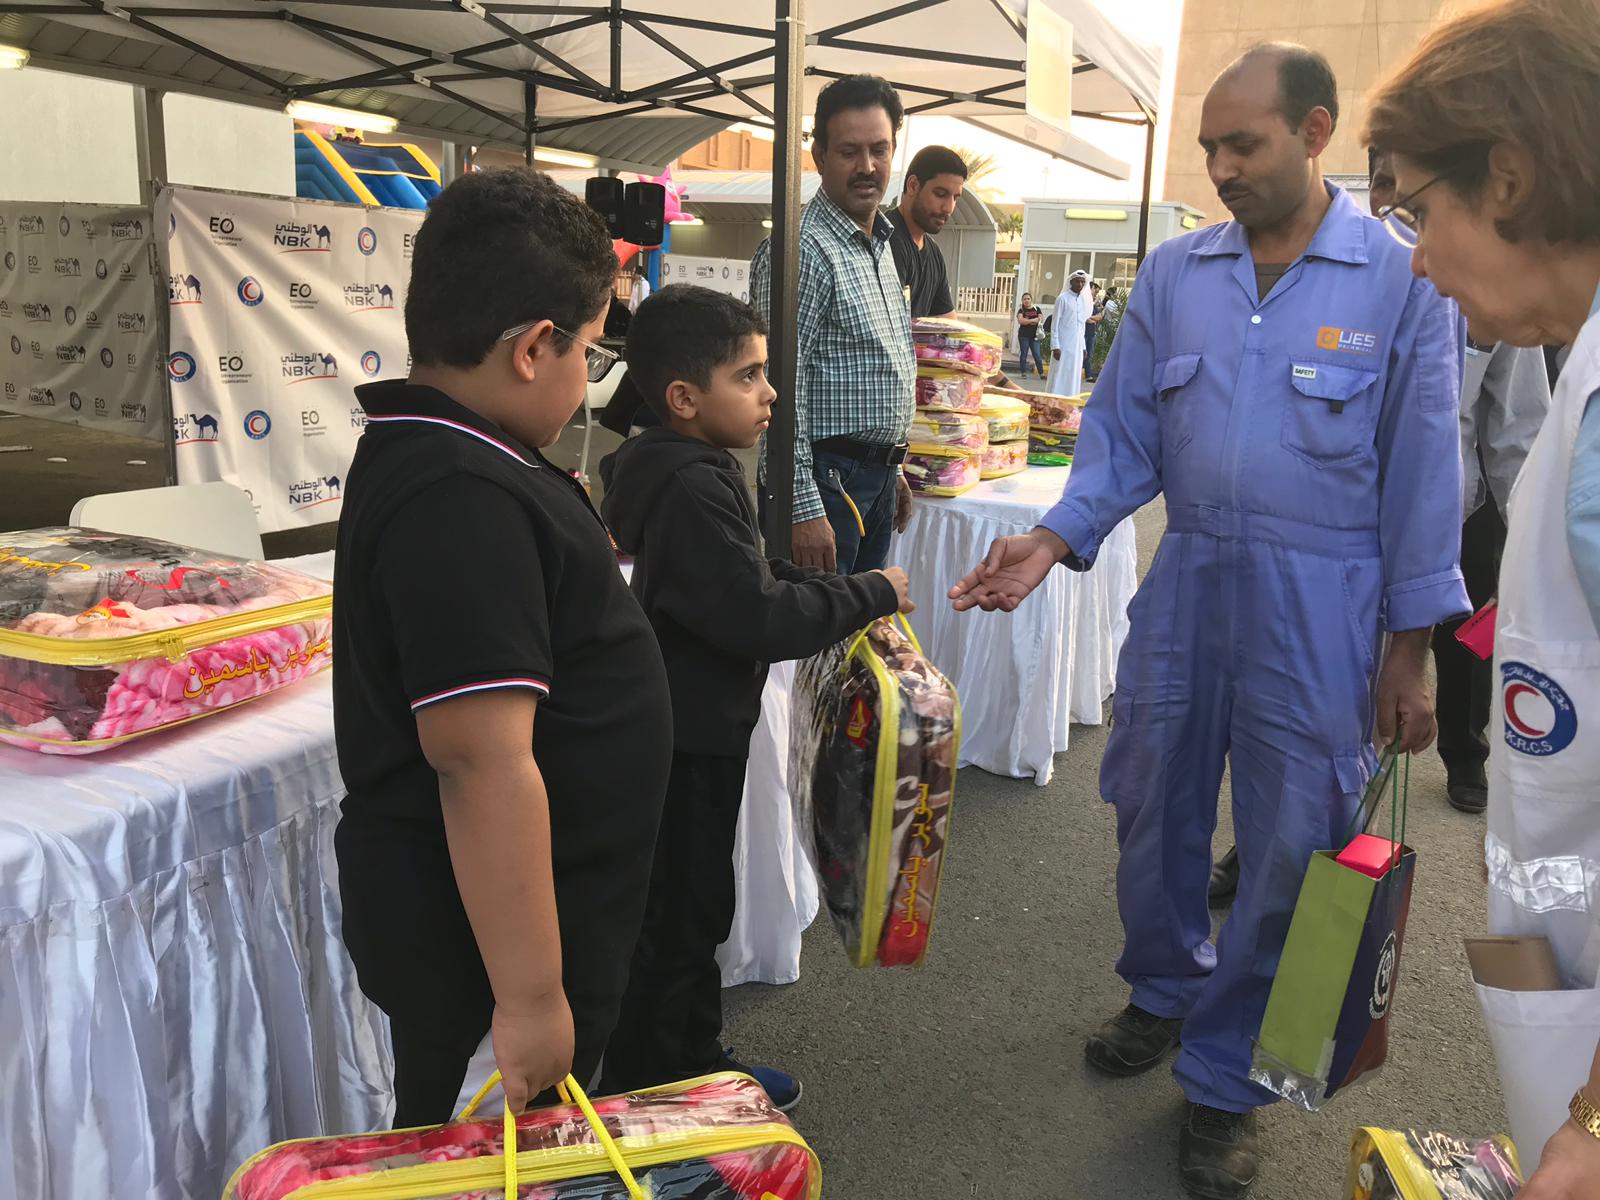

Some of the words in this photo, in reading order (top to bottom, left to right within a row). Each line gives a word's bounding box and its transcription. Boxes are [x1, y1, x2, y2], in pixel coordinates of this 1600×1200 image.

[210, 216, 235, 234] EO
[275, 222, 313, 237] الوطني
[274, 235, 311, 248] NBK
[289, 283, 312, 298] EO
[344, 295, 375, 306] NBK
[1339, 330, 1376, 347] UES
[219, 355, 244, 372] EO
[281, 353, 317, 365] الوطني
[282, 365, 316, 377] NBK
[1295, 368, 1315, 377] SAFETY
[301, 410, 320, 426] EO
[289, 491, 323, 505] NBK
[183, 646, 272, 700] ياسمين
[896, 856, 928, 938] ياسمين
